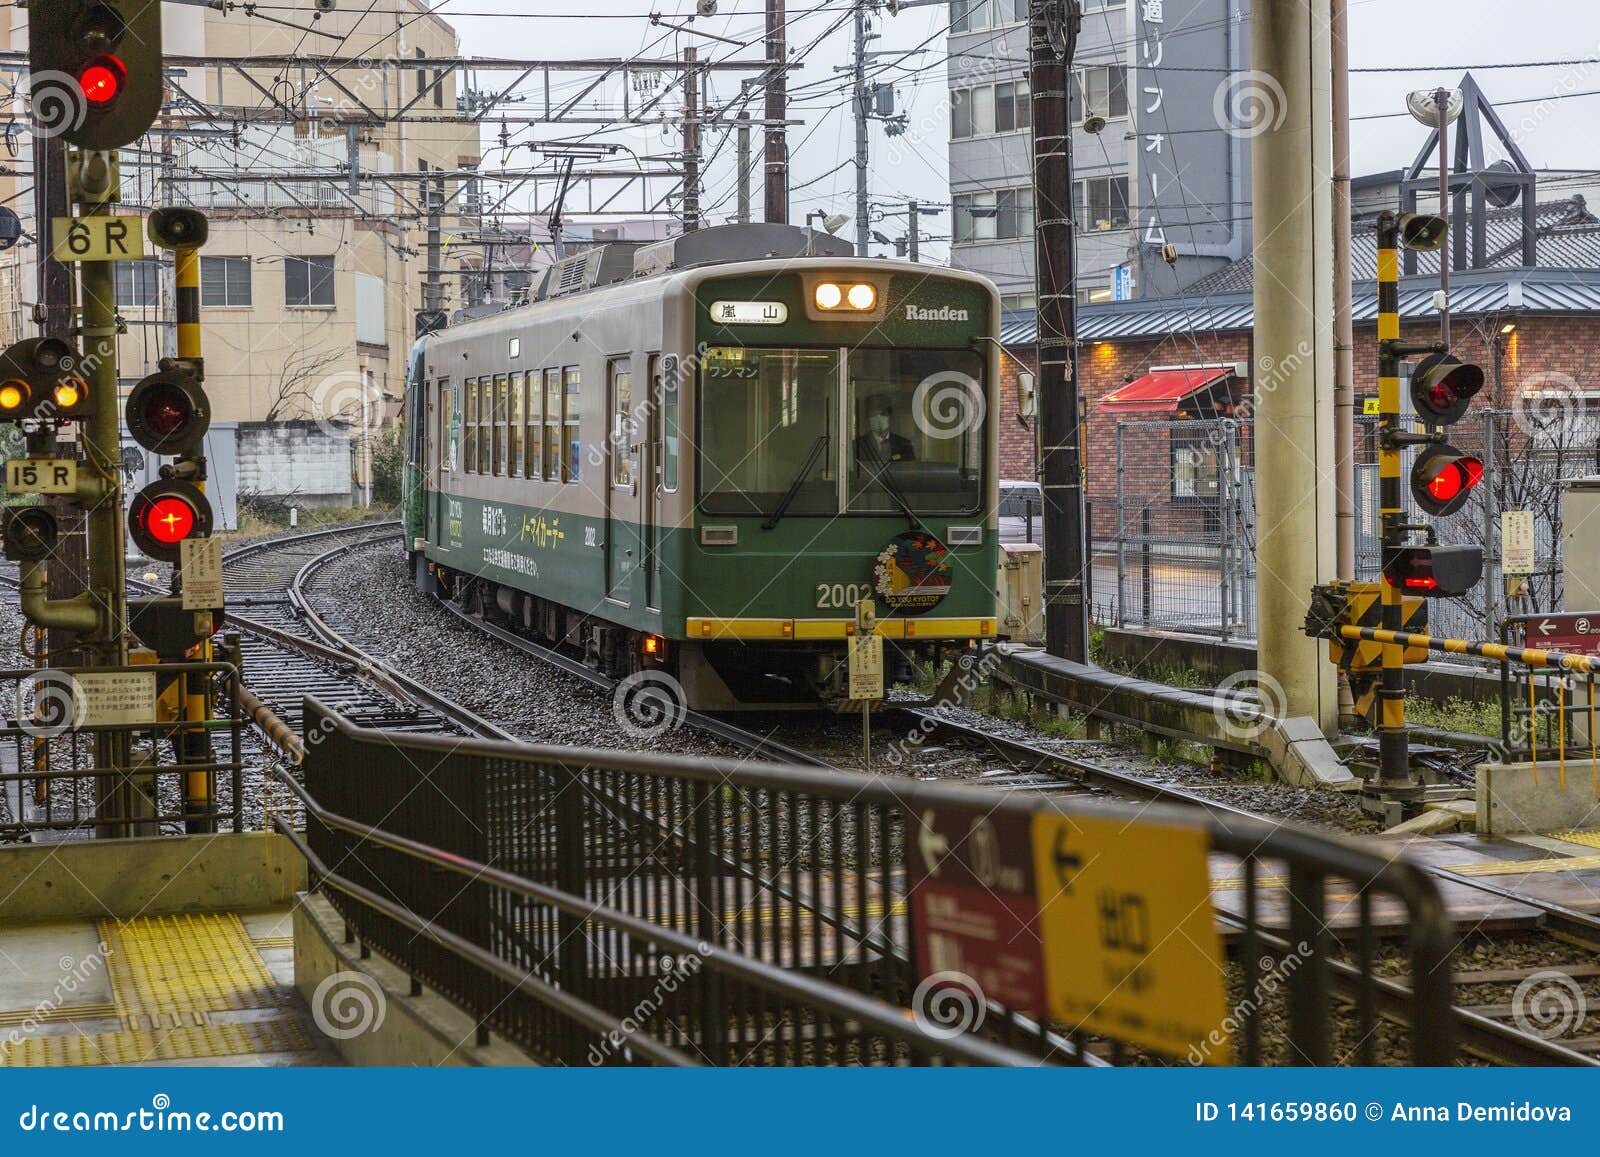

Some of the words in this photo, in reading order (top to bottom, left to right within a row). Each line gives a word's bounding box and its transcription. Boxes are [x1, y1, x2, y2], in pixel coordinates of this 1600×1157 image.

[68, 223, 90, 255] 6
[105, 222, 128, 254] R
[722, 305, 778, 319] 嵐山
[906, 304, 969, 321] Randen
[710, 367, 758, 378] ワンマン
[14, 466, 38, 486] 15
[54, 466, 69, 485] R
[585, 526, 596, 547] 2002
